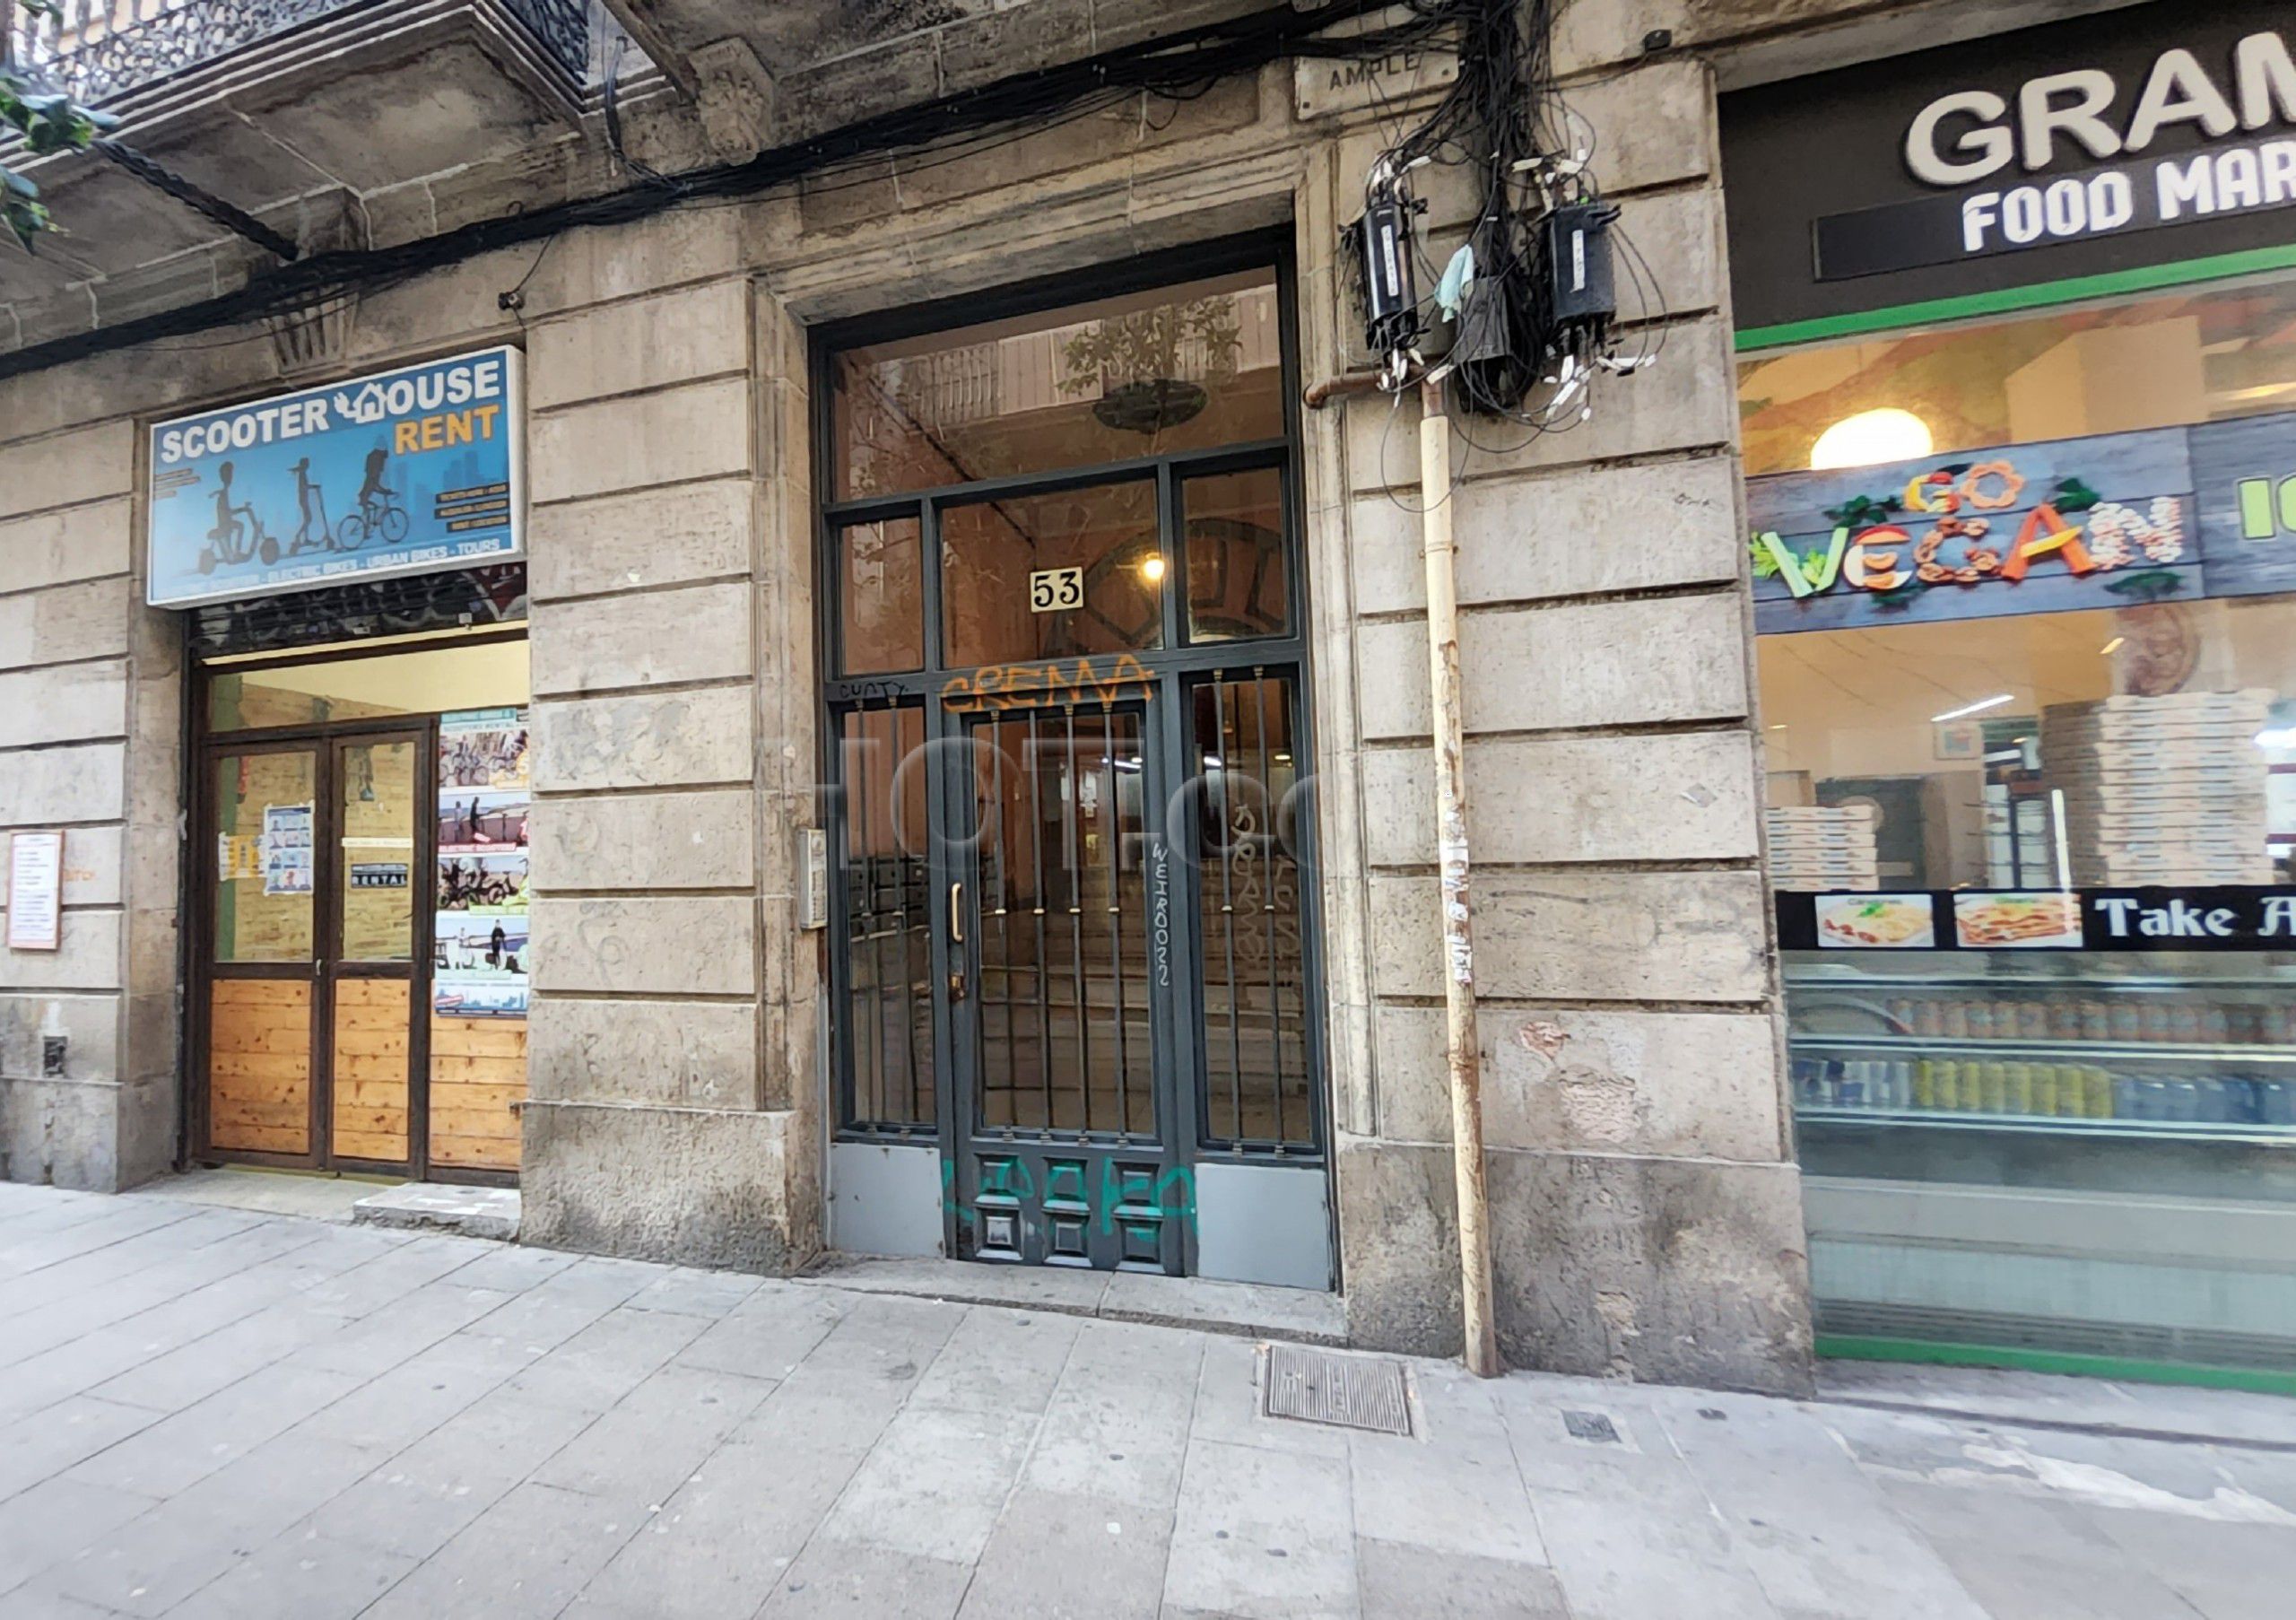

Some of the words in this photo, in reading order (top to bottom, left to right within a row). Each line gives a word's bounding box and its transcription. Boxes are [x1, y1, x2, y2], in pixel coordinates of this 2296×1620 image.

[1330, 52, 1420, 91] AMPLE
[1962, 170, 2133, 252] FOOD
[161, 399, 329, 463] SCOOTER
[394, 405, 500, 455] RENT
[1903, 459, 2025, 513] GO
[367, 552, 408, 569] URBAN
[411, 545, 448, 562] BIKES
[457, 538, 500, 555] TOURS
[1758, 497, 2183, 598] VEGAN
[1034, 571, 1080, 607] 53
[942, 654, 1155, 714] CREMA
[2094, 898, 2240, 937] Take
